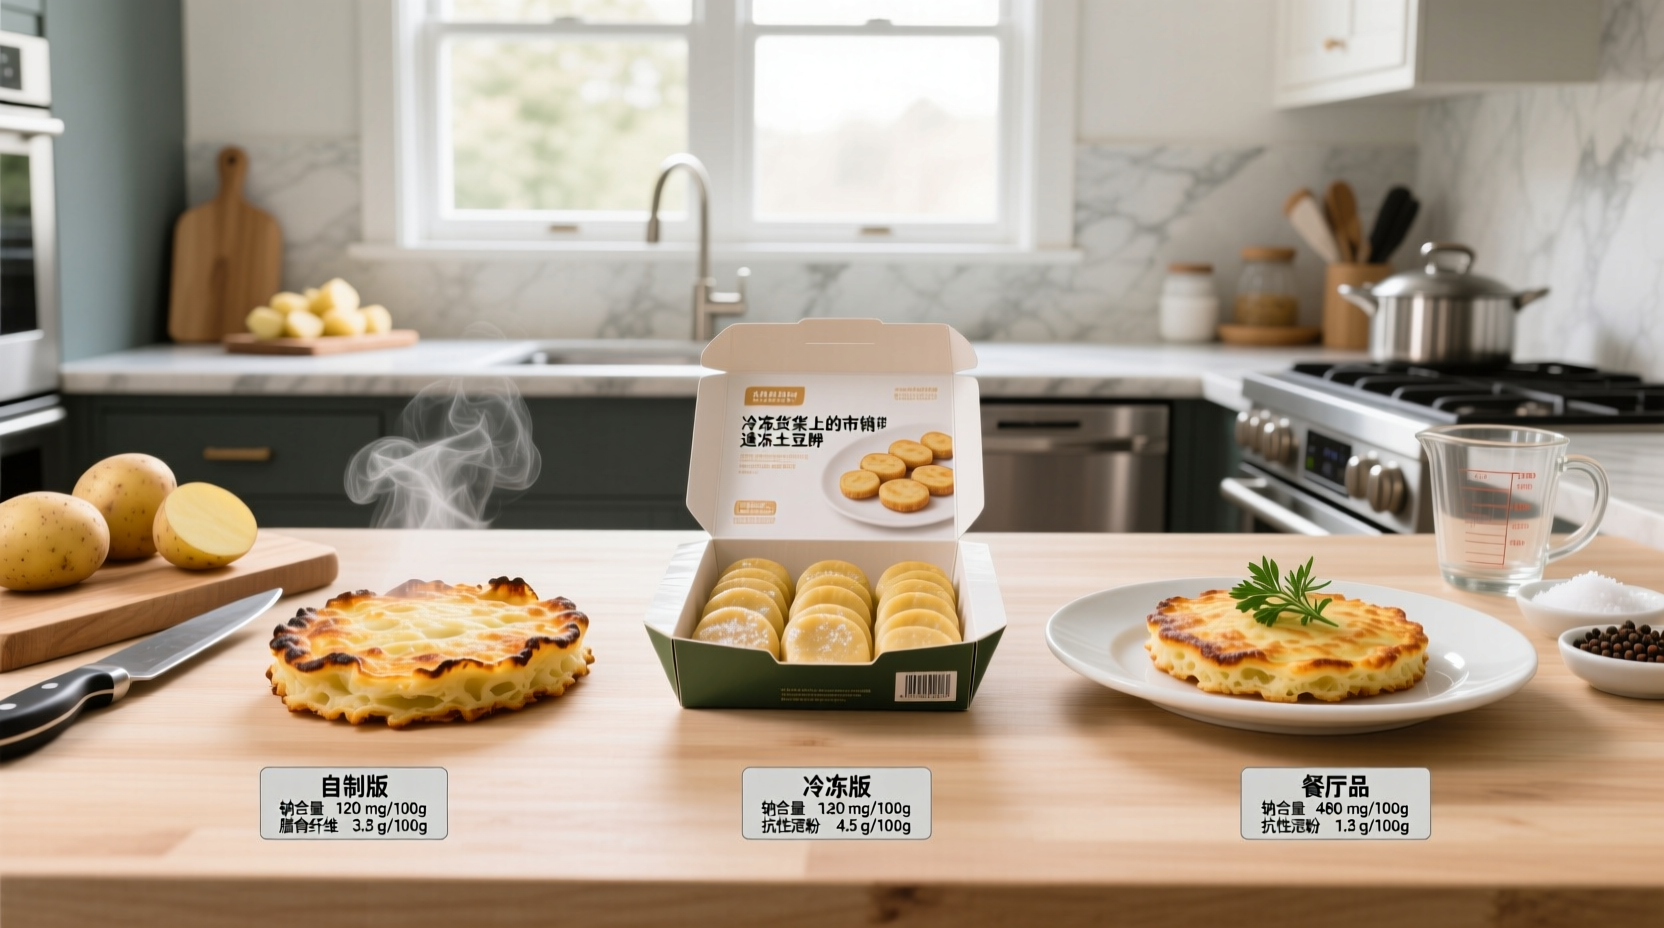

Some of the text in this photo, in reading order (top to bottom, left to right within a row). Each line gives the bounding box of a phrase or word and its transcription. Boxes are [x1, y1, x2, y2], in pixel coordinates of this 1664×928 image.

[322, 774, 389, 799] 自制版
[803, 774, 872, 798] 冷冻版
[1302, 774, 1370, 798] 餐厅品
[337, 801, 362, 815] 120
[365, 801, 427, 818] mg/100g
[817, 801, 846, 815] 120
[848, 801, 911, 818] mg/100g
[1346, 801, 1409, 818] mg/100g
[377, 818, 428, 835] g/100g
[836, 818, 858, 833] 4.5
[861, 818, 911, 835] g/100g
[1359, 818, 1410, 835] g/100g
